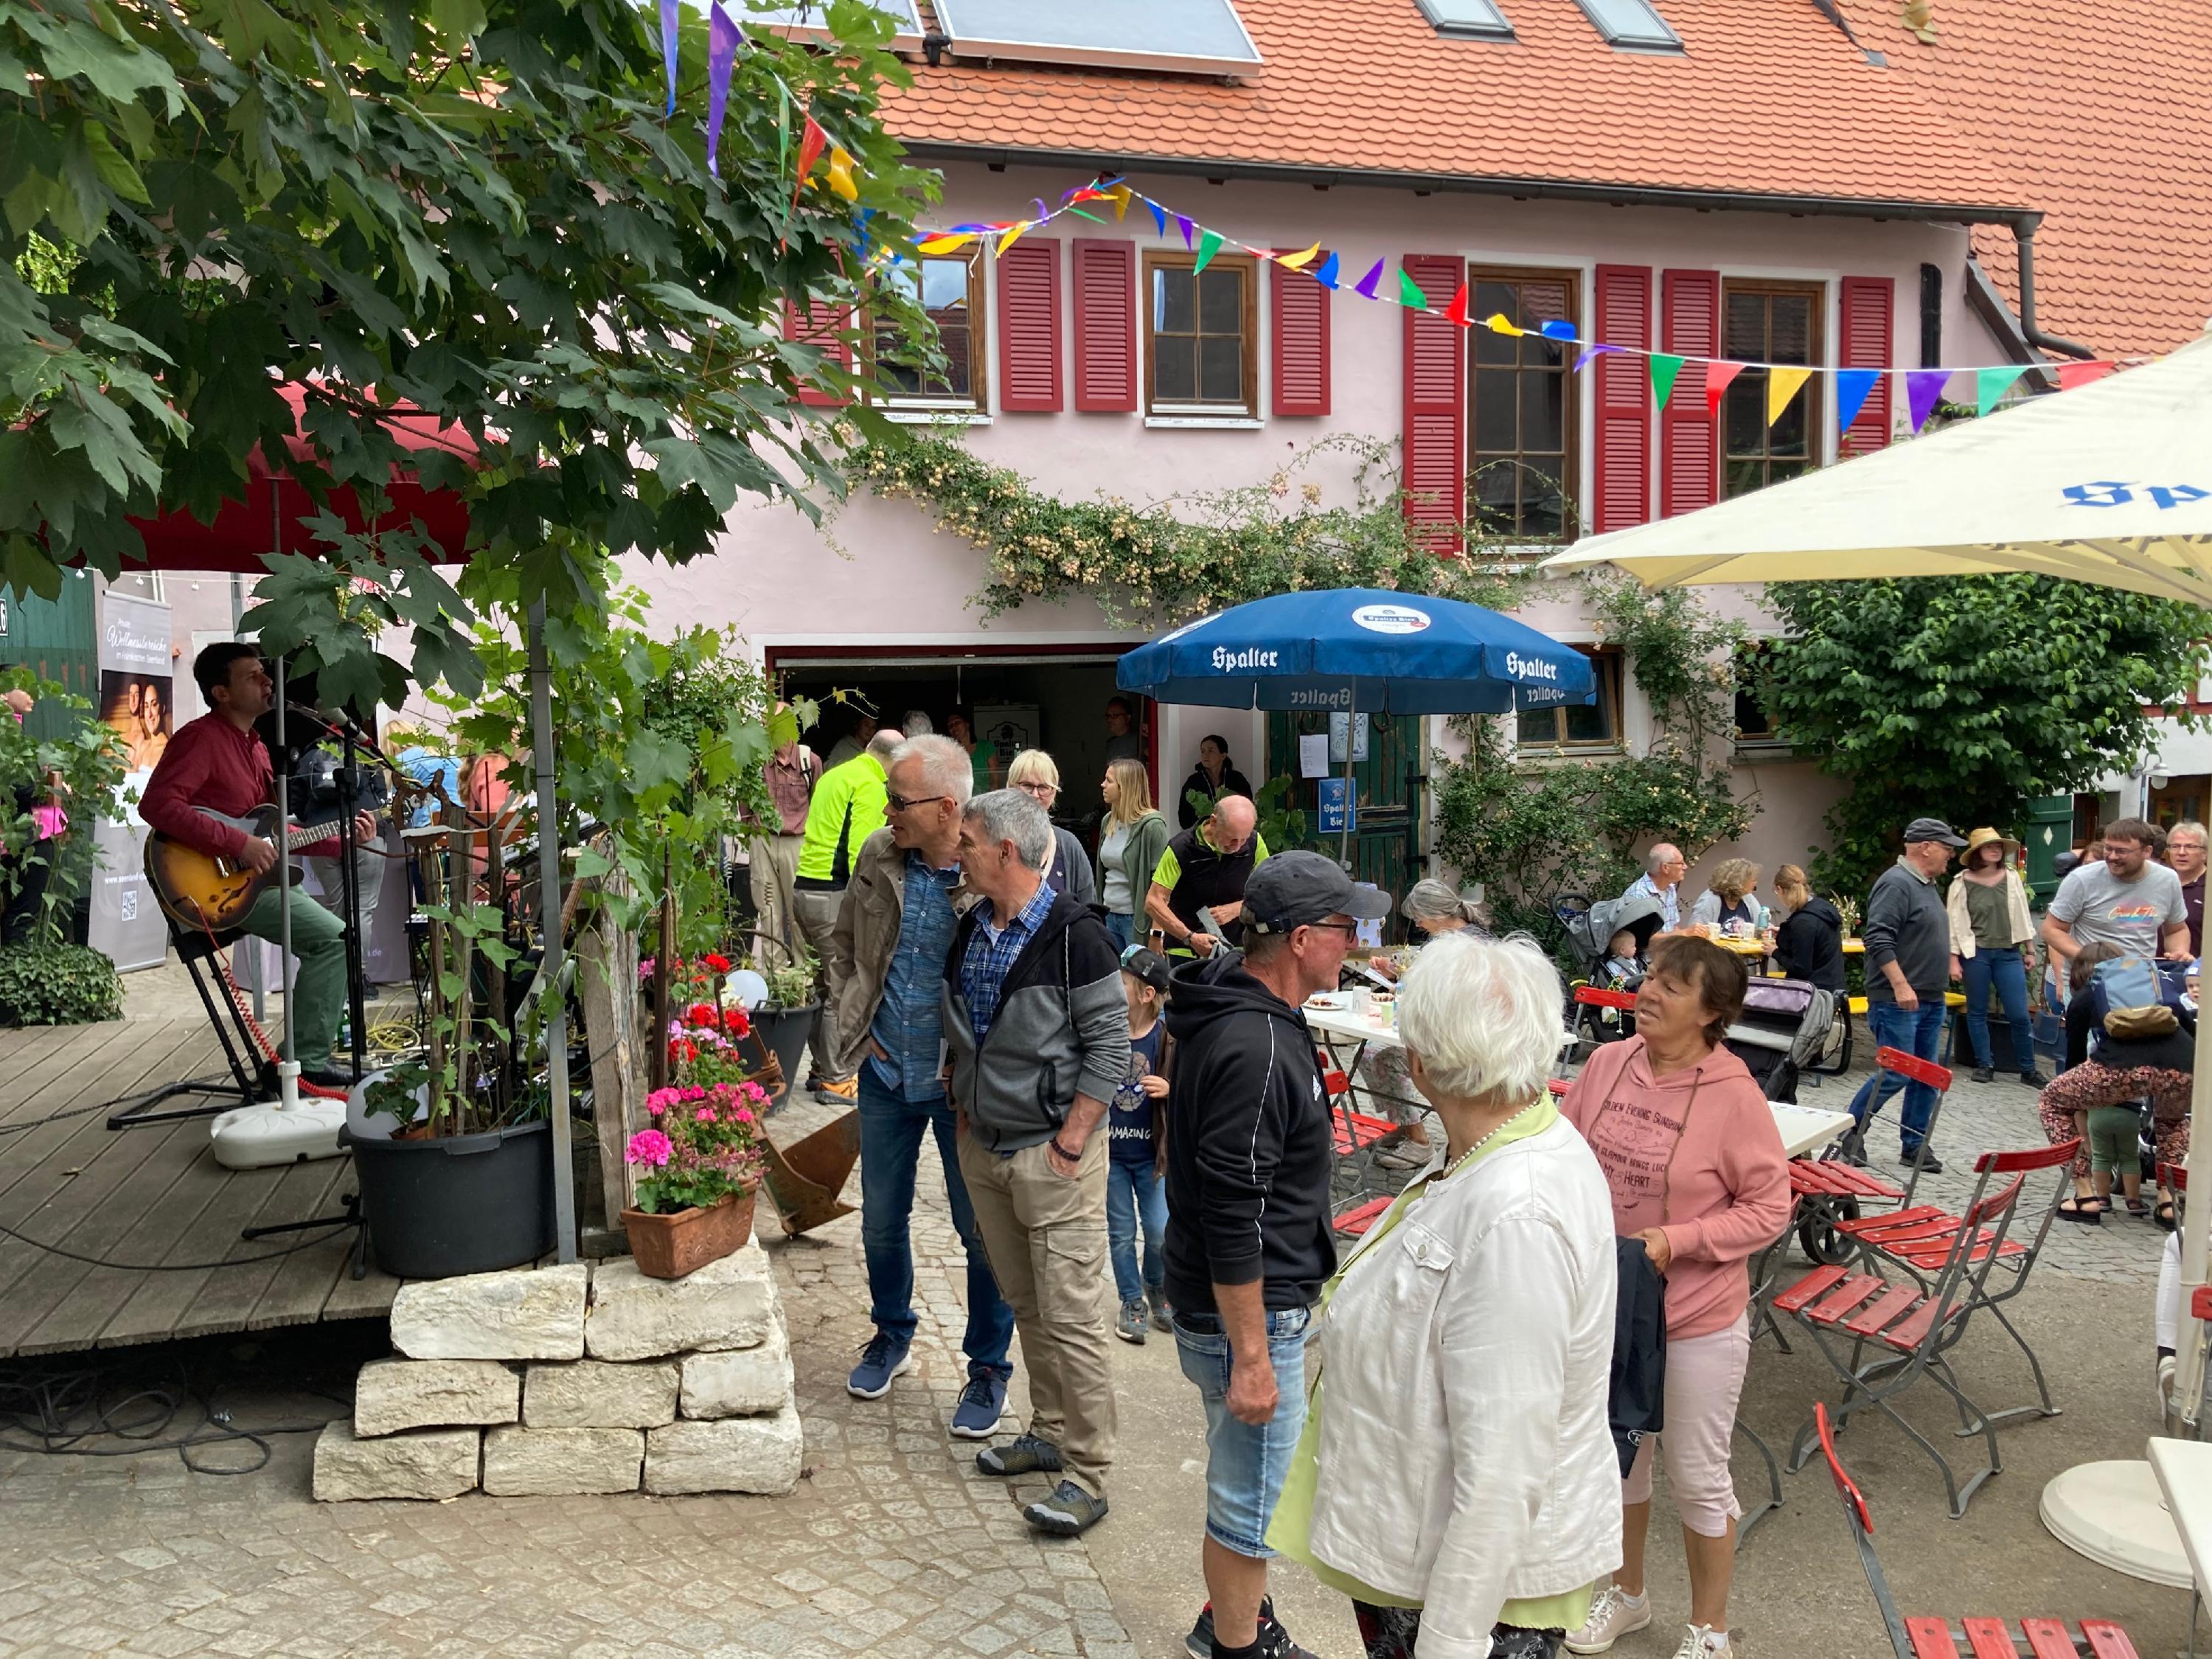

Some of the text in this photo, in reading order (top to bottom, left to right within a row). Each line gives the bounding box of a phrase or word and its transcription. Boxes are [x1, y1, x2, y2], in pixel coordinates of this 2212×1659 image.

[0, 602, 6, 632] 6
[1211, 646, 1278, 672] Spalter
[1506, 651, 1557, 680] Spalter
[1323, 803, 1352, 815] Spaltr
[1329, 817, 1344, 827] Bie
[1109, 1125, 1151, 1139] AMAZING
[1624, 1170, 1650, 1189] HEART
